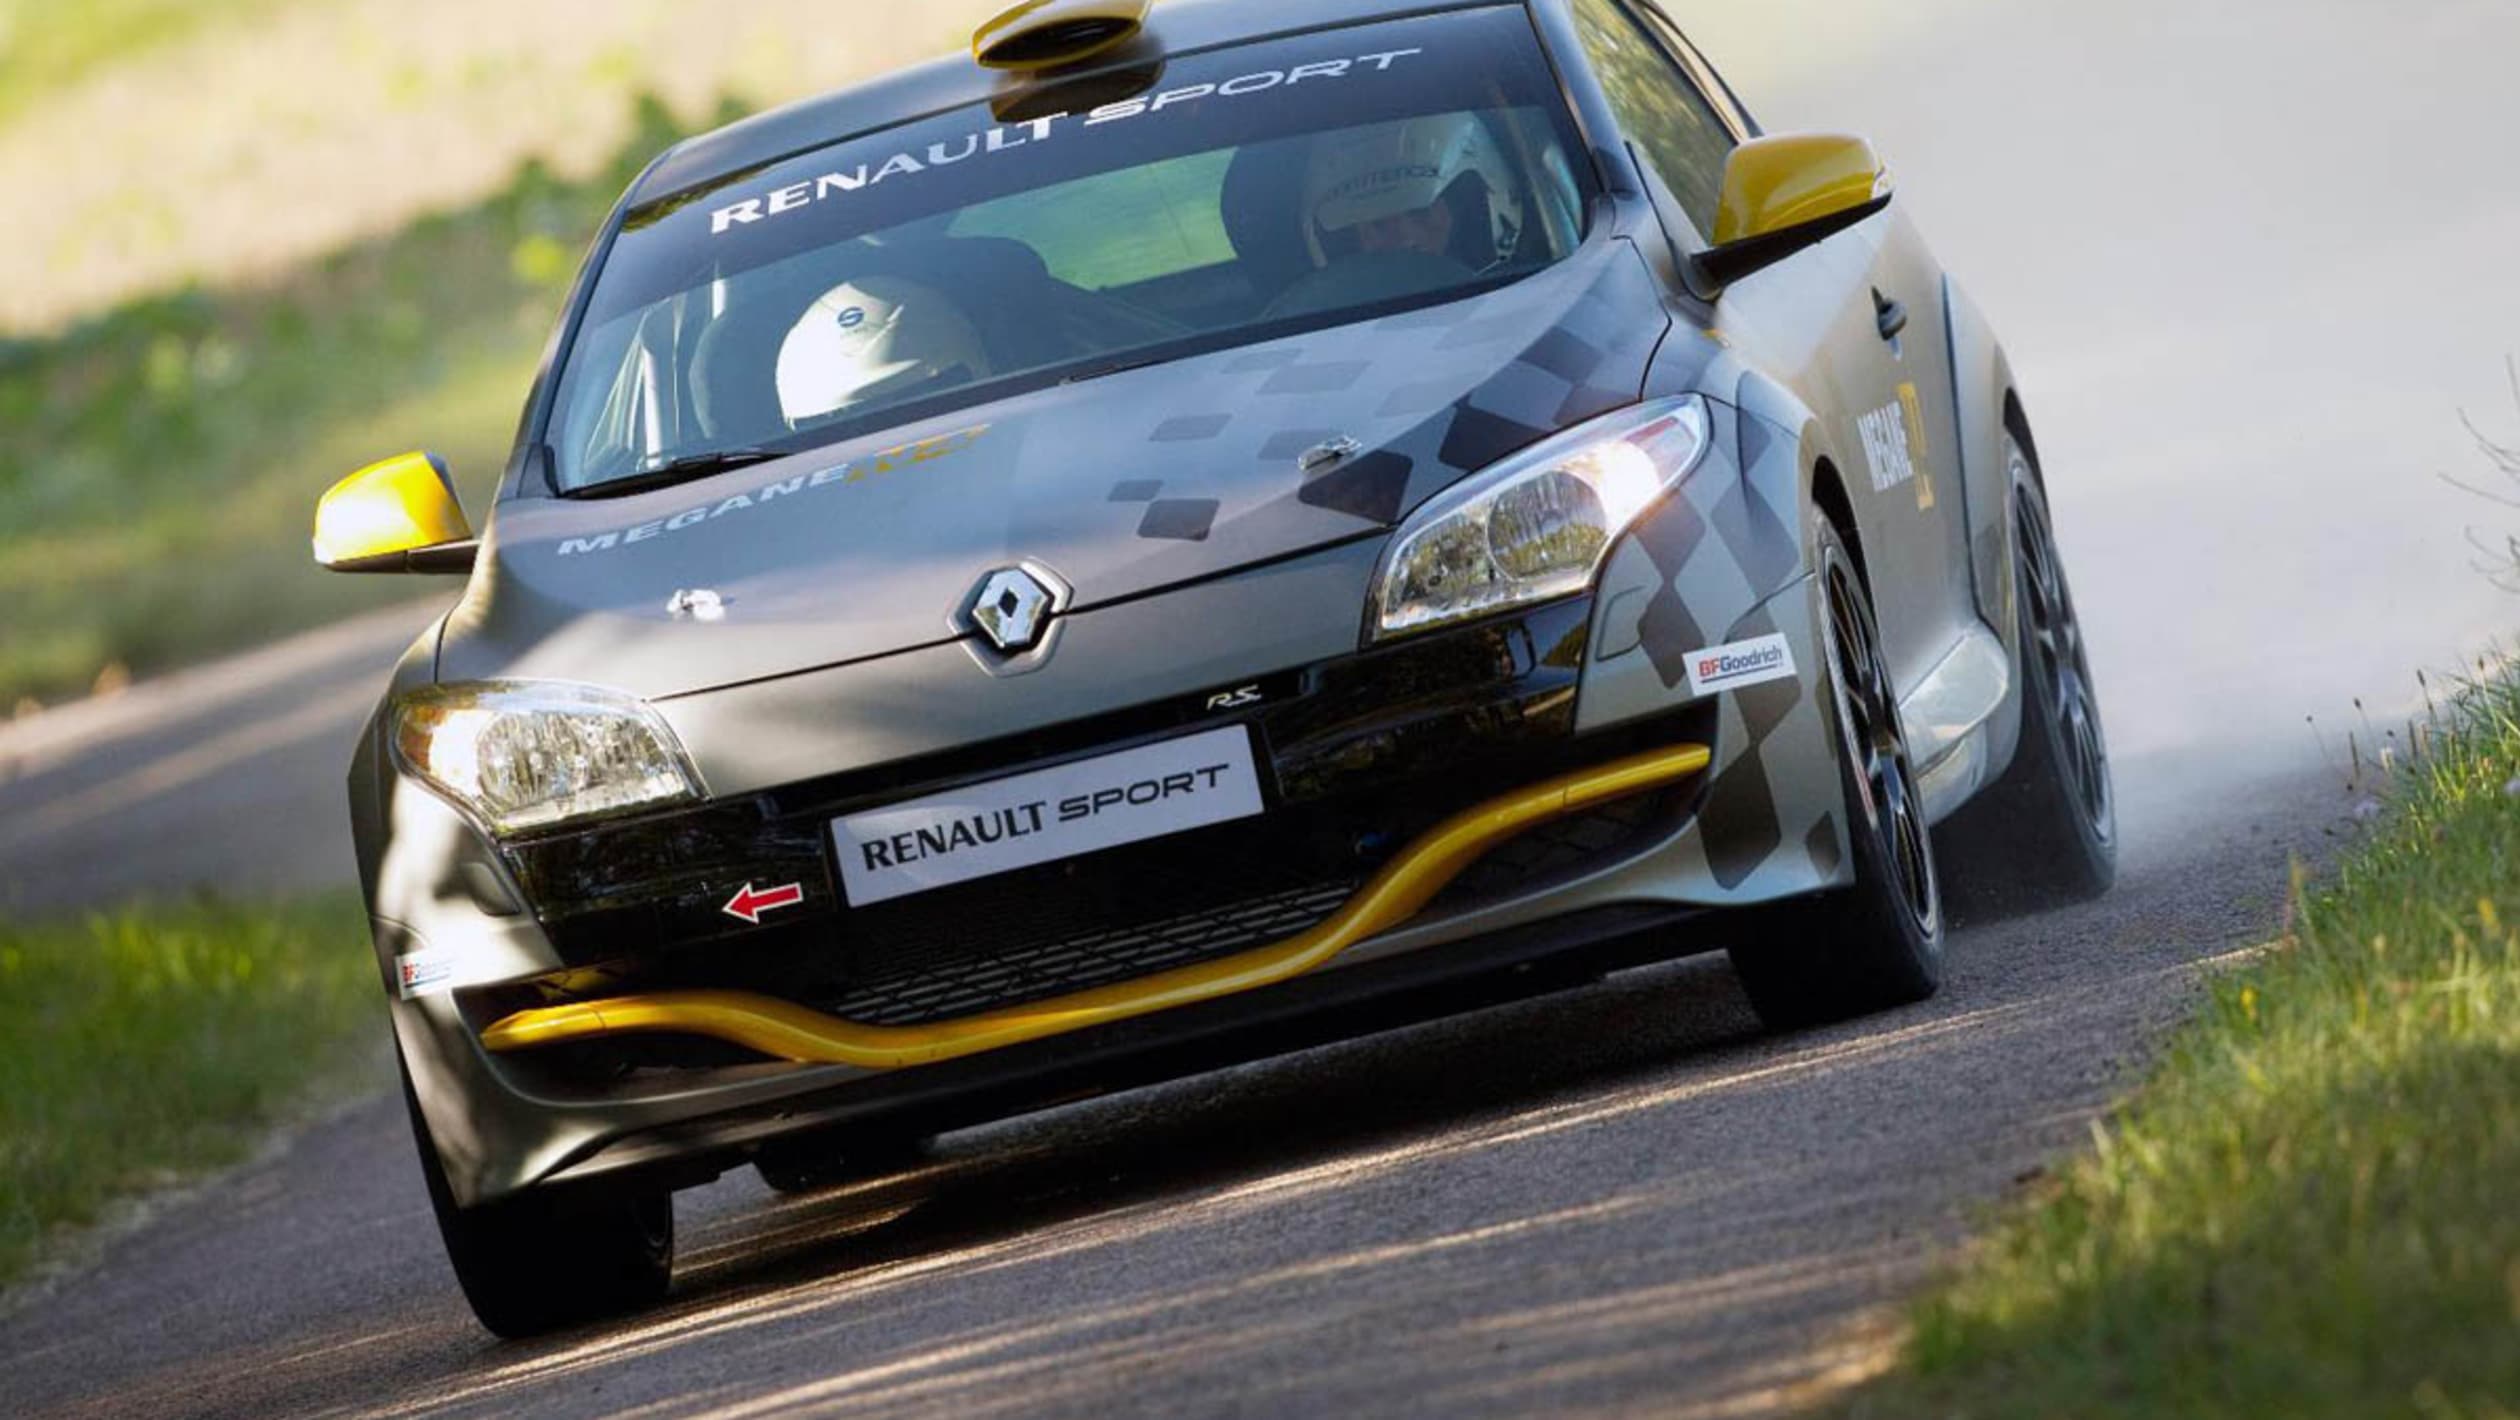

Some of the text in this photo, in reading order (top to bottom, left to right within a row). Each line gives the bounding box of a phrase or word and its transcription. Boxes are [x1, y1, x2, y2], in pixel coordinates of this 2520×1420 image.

[710, 48, 1422, 235] RENAULT SPORT
[556, 463, 849, 555] MEGANE
[1205, 684, 1262, 711] RS
[1698, 644, 1783, 677] BFGoodrich
[861, 764, 1230, 871] RENAULT SPORT
